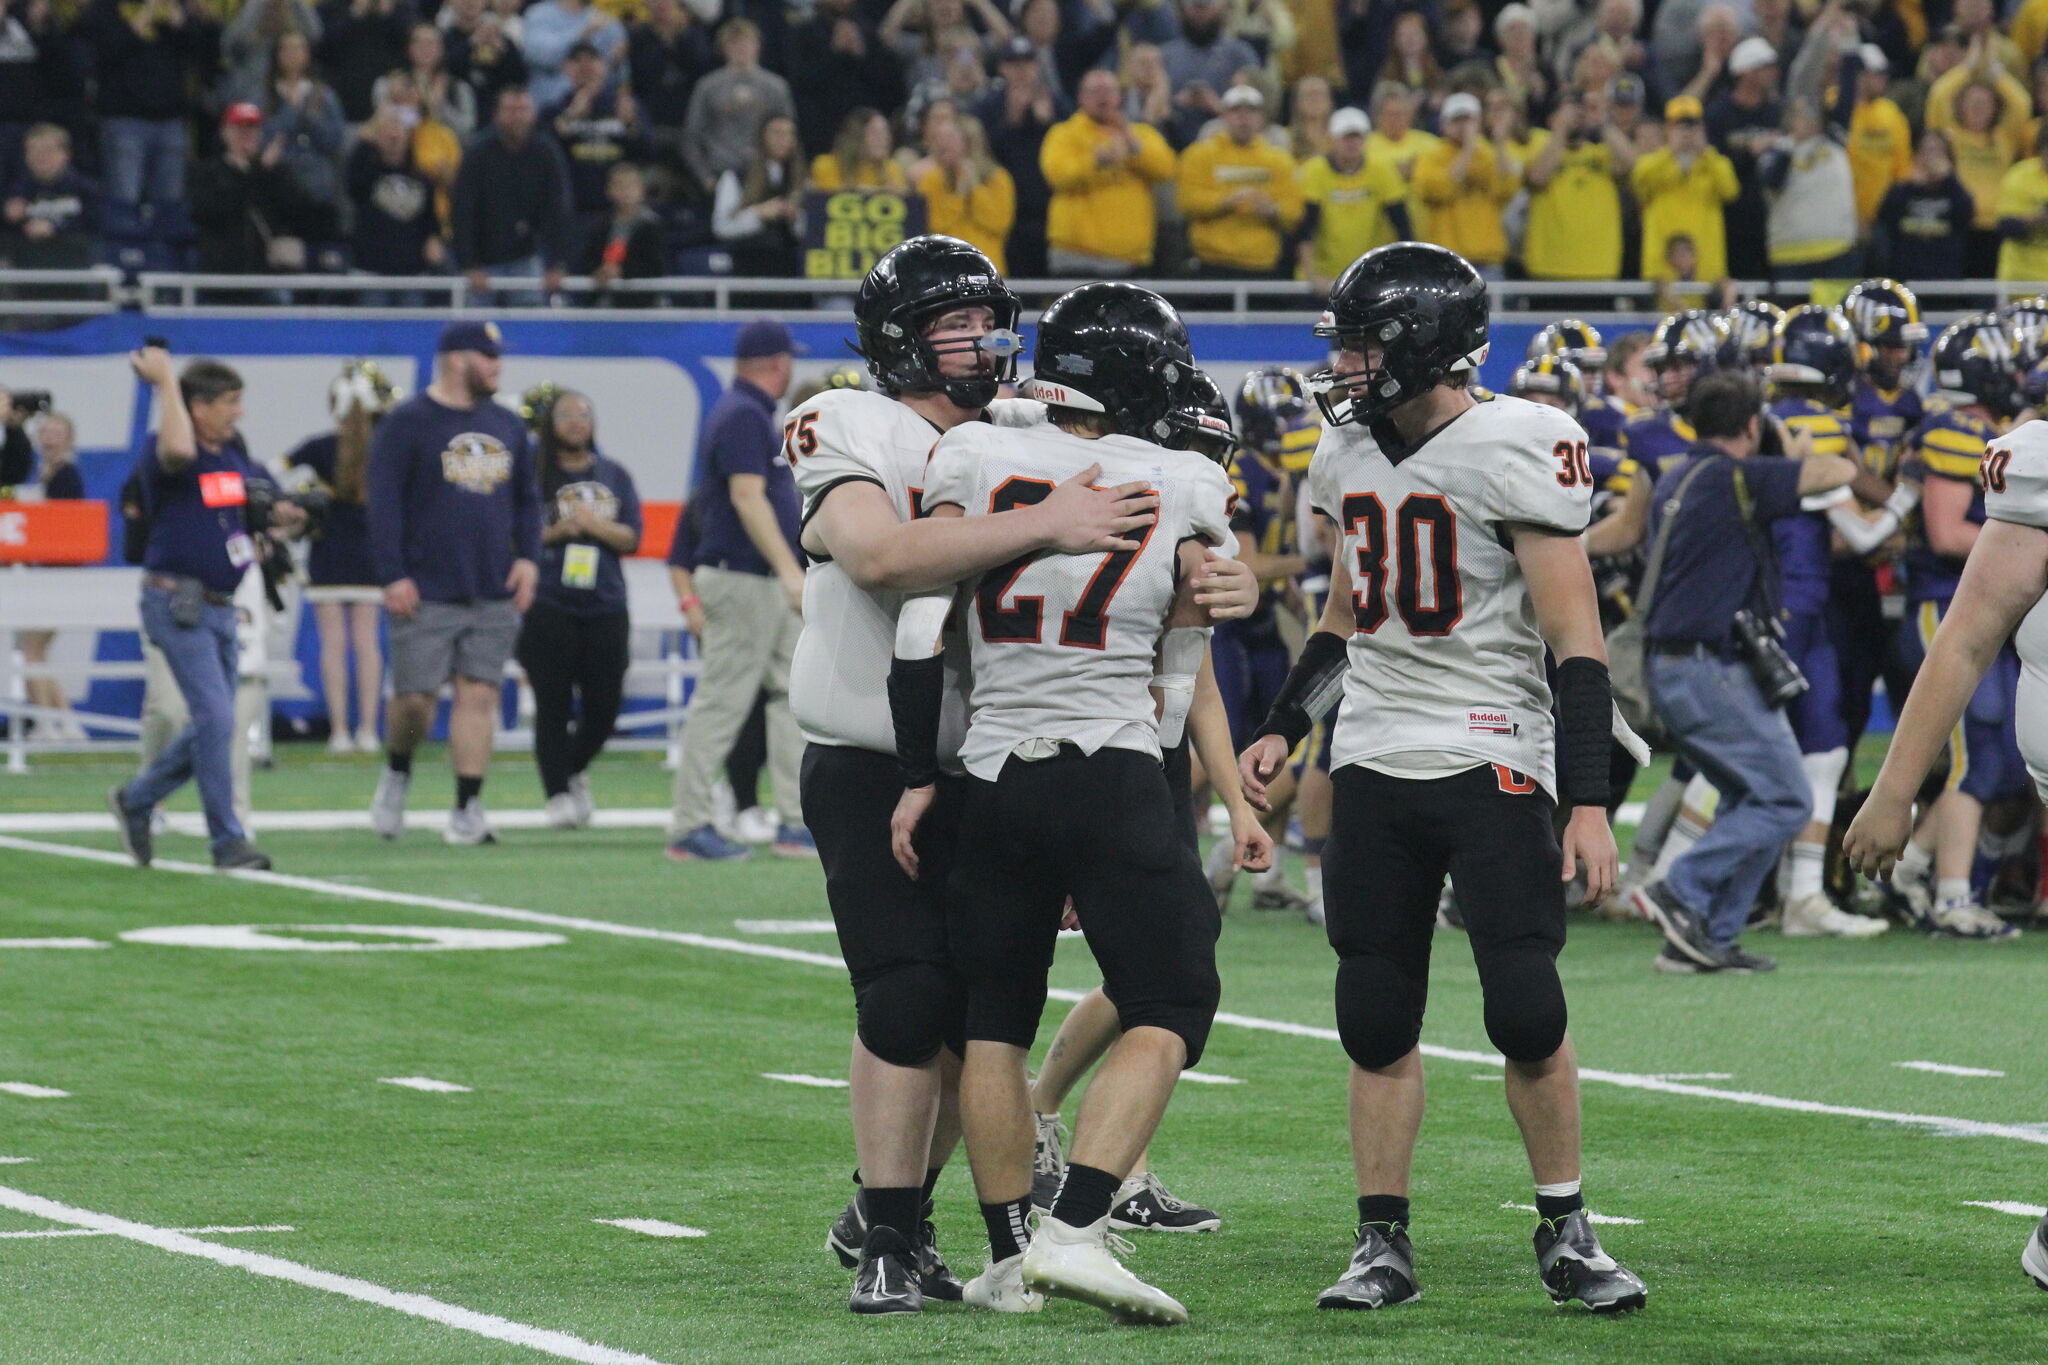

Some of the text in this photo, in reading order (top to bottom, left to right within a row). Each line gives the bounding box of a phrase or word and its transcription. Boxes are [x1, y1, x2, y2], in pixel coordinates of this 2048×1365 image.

[826, 193, 908, 222] GO
[824, 220, 904, 251] BIG
[784, 410, 820, 468] 75
[1552, 440, 1595, 488] 30
[974, 474, 1160, 651] 27
[1341, 491, 1464, 637] 30
[1469, 712, 1508, 722] Riddell
